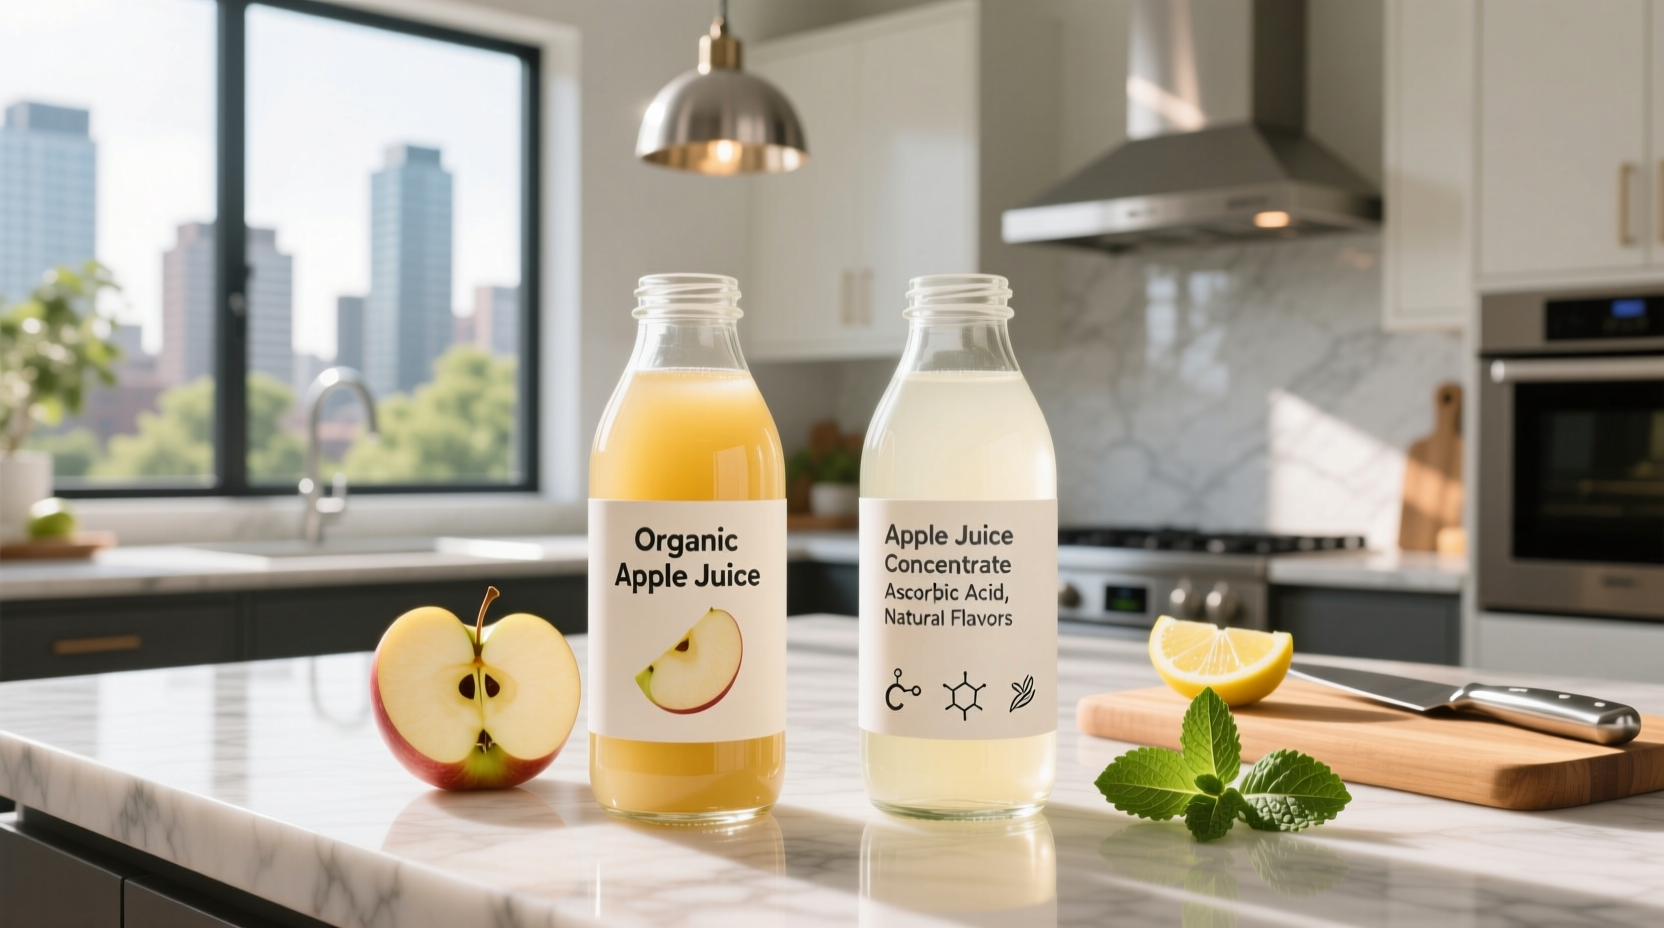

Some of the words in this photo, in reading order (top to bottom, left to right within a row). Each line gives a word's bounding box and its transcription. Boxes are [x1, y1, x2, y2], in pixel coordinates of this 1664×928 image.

[634, 526, 738, 558] Organic
[885, 523, 949, 550] Apple
[955, 524, 1014, 546] Juice
[885, 553, 1012, 574] Concentrate
[615, 562, 687, 594] Apple
[694, 562, 761, 588] Juice
[964, 583, 1009, 604] Acid,
[885, 608, 945, 626] Natural
[951, 608, 1013, 627] Flavors
